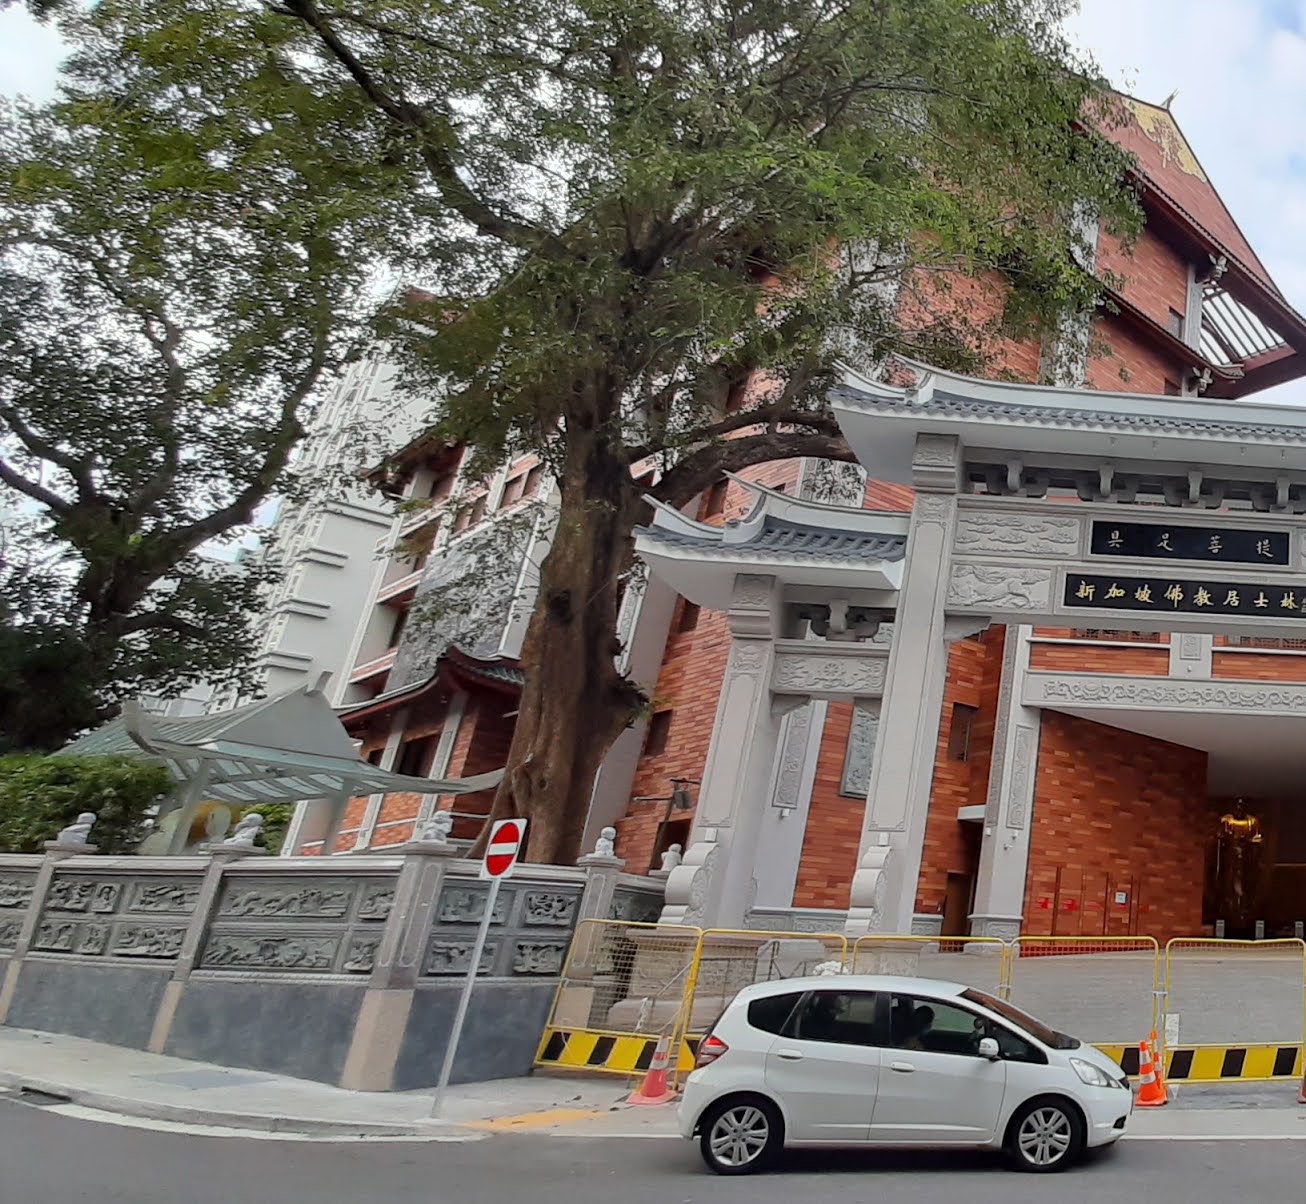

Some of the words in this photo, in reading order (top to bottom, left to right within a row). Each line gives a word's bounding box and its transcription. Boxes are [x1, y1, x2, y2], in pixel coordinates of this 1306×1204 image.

[1107, 530, 1274, 558] 具足菩提
[1075, 579, 1299, 610] 新加坡佛教居士林
